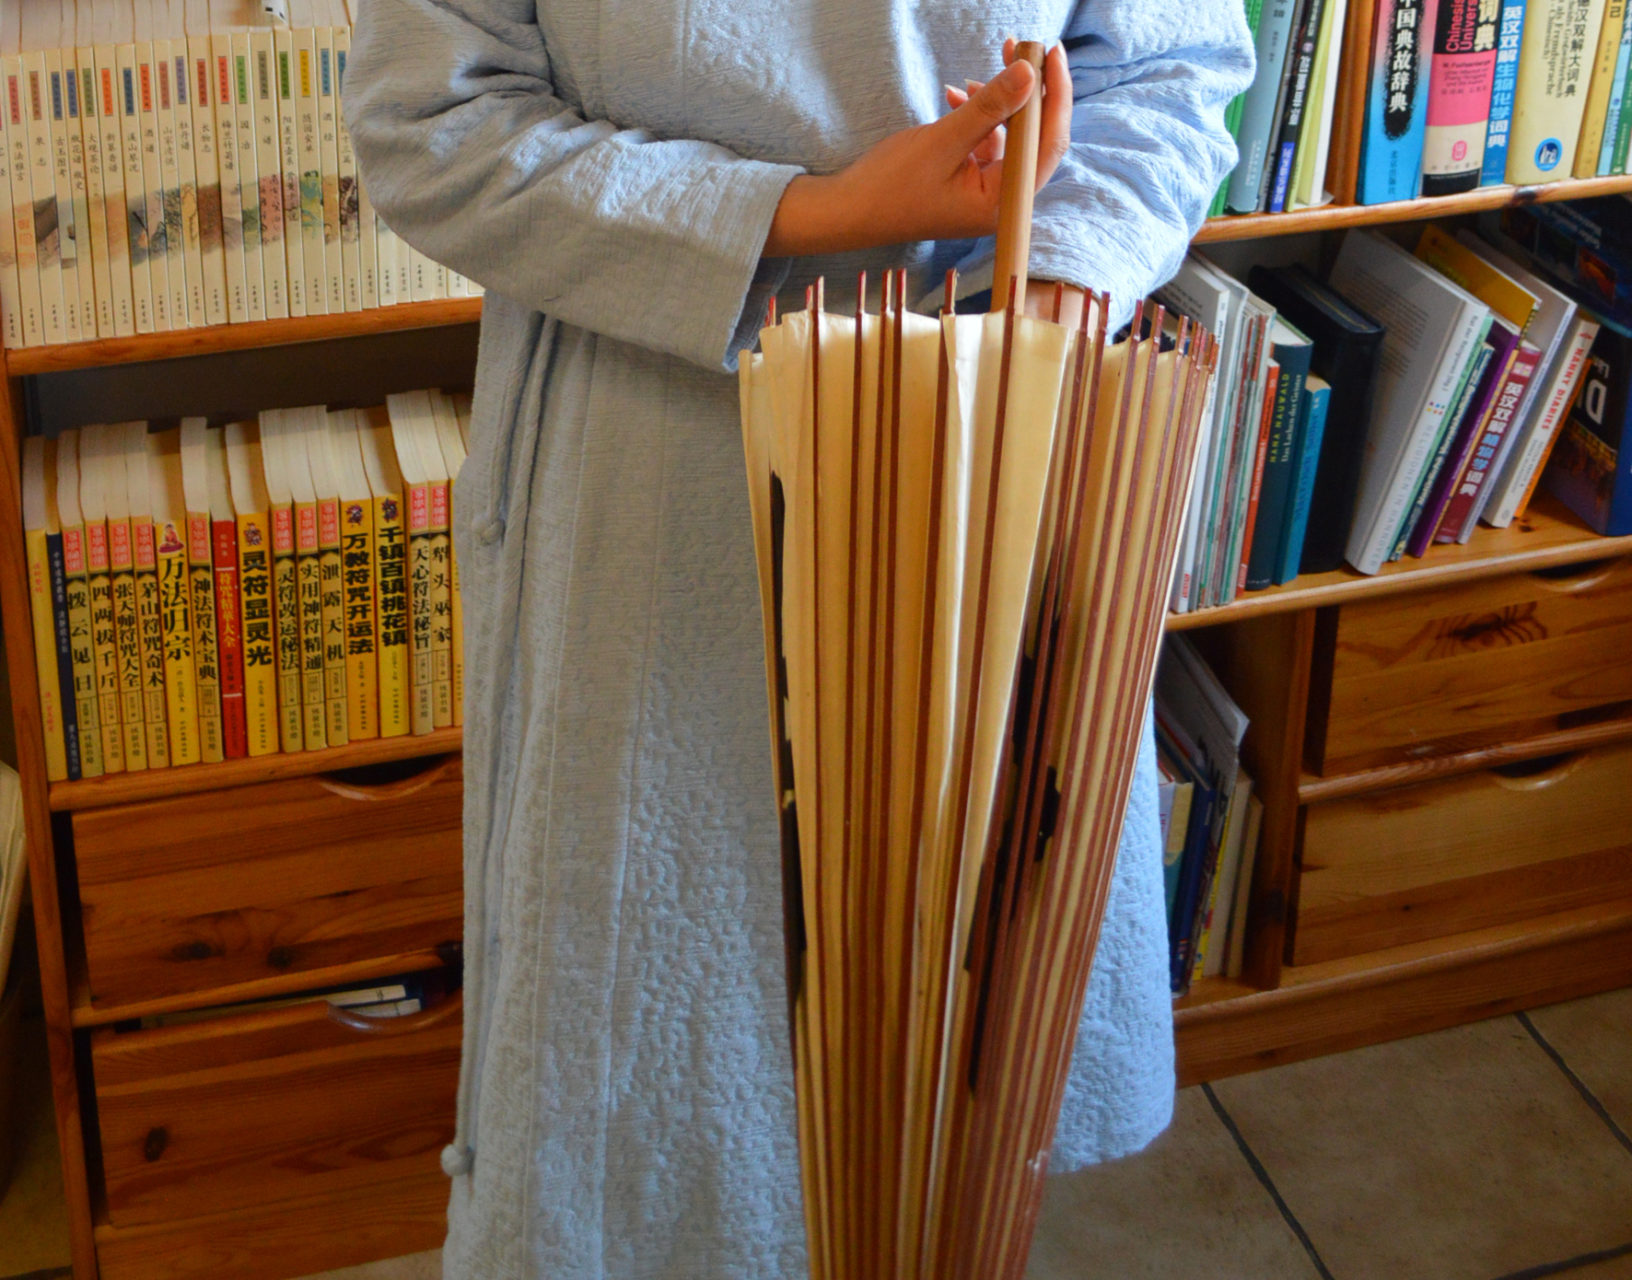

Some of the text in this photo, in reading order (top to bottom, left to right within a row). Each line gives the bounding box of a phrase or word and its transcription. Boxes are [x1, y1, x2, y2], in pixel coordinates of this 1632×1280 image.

[1488, 6, 1524, 149] 英汉双解生物化学词典
[1546, 23, 1563, 95] Fremdsprache
[1269, 373, 1290, 463] HANA NAUWALD
[1283, 417, 1294, 442] Lachen
[1289, 374, 1302, 402] Geister
[1541, 346, 1585, 431] NANNY DIARIES
[1281, 442, 1290, 463] Das
[115, 582, 142, 688] 张天师符咒大全
[140, 581, 164, 688] 茅山符咒奇术
[160, 553, 191, 661] 万法归宗
[193, 577, 216, 681] 神法符术宝典
[242, 550, 273, 668] 灵符显灵光
[277, 566, 301, 672] 灵符改运秘法
[301, 563, 323, 671] 实用神符精通
[378, 525, 408, 648] 千镇百镇桃花镇
[411, 545, 432, 651] 天心符法秘旨
[67, 590, 94, 693] 拨云见日
